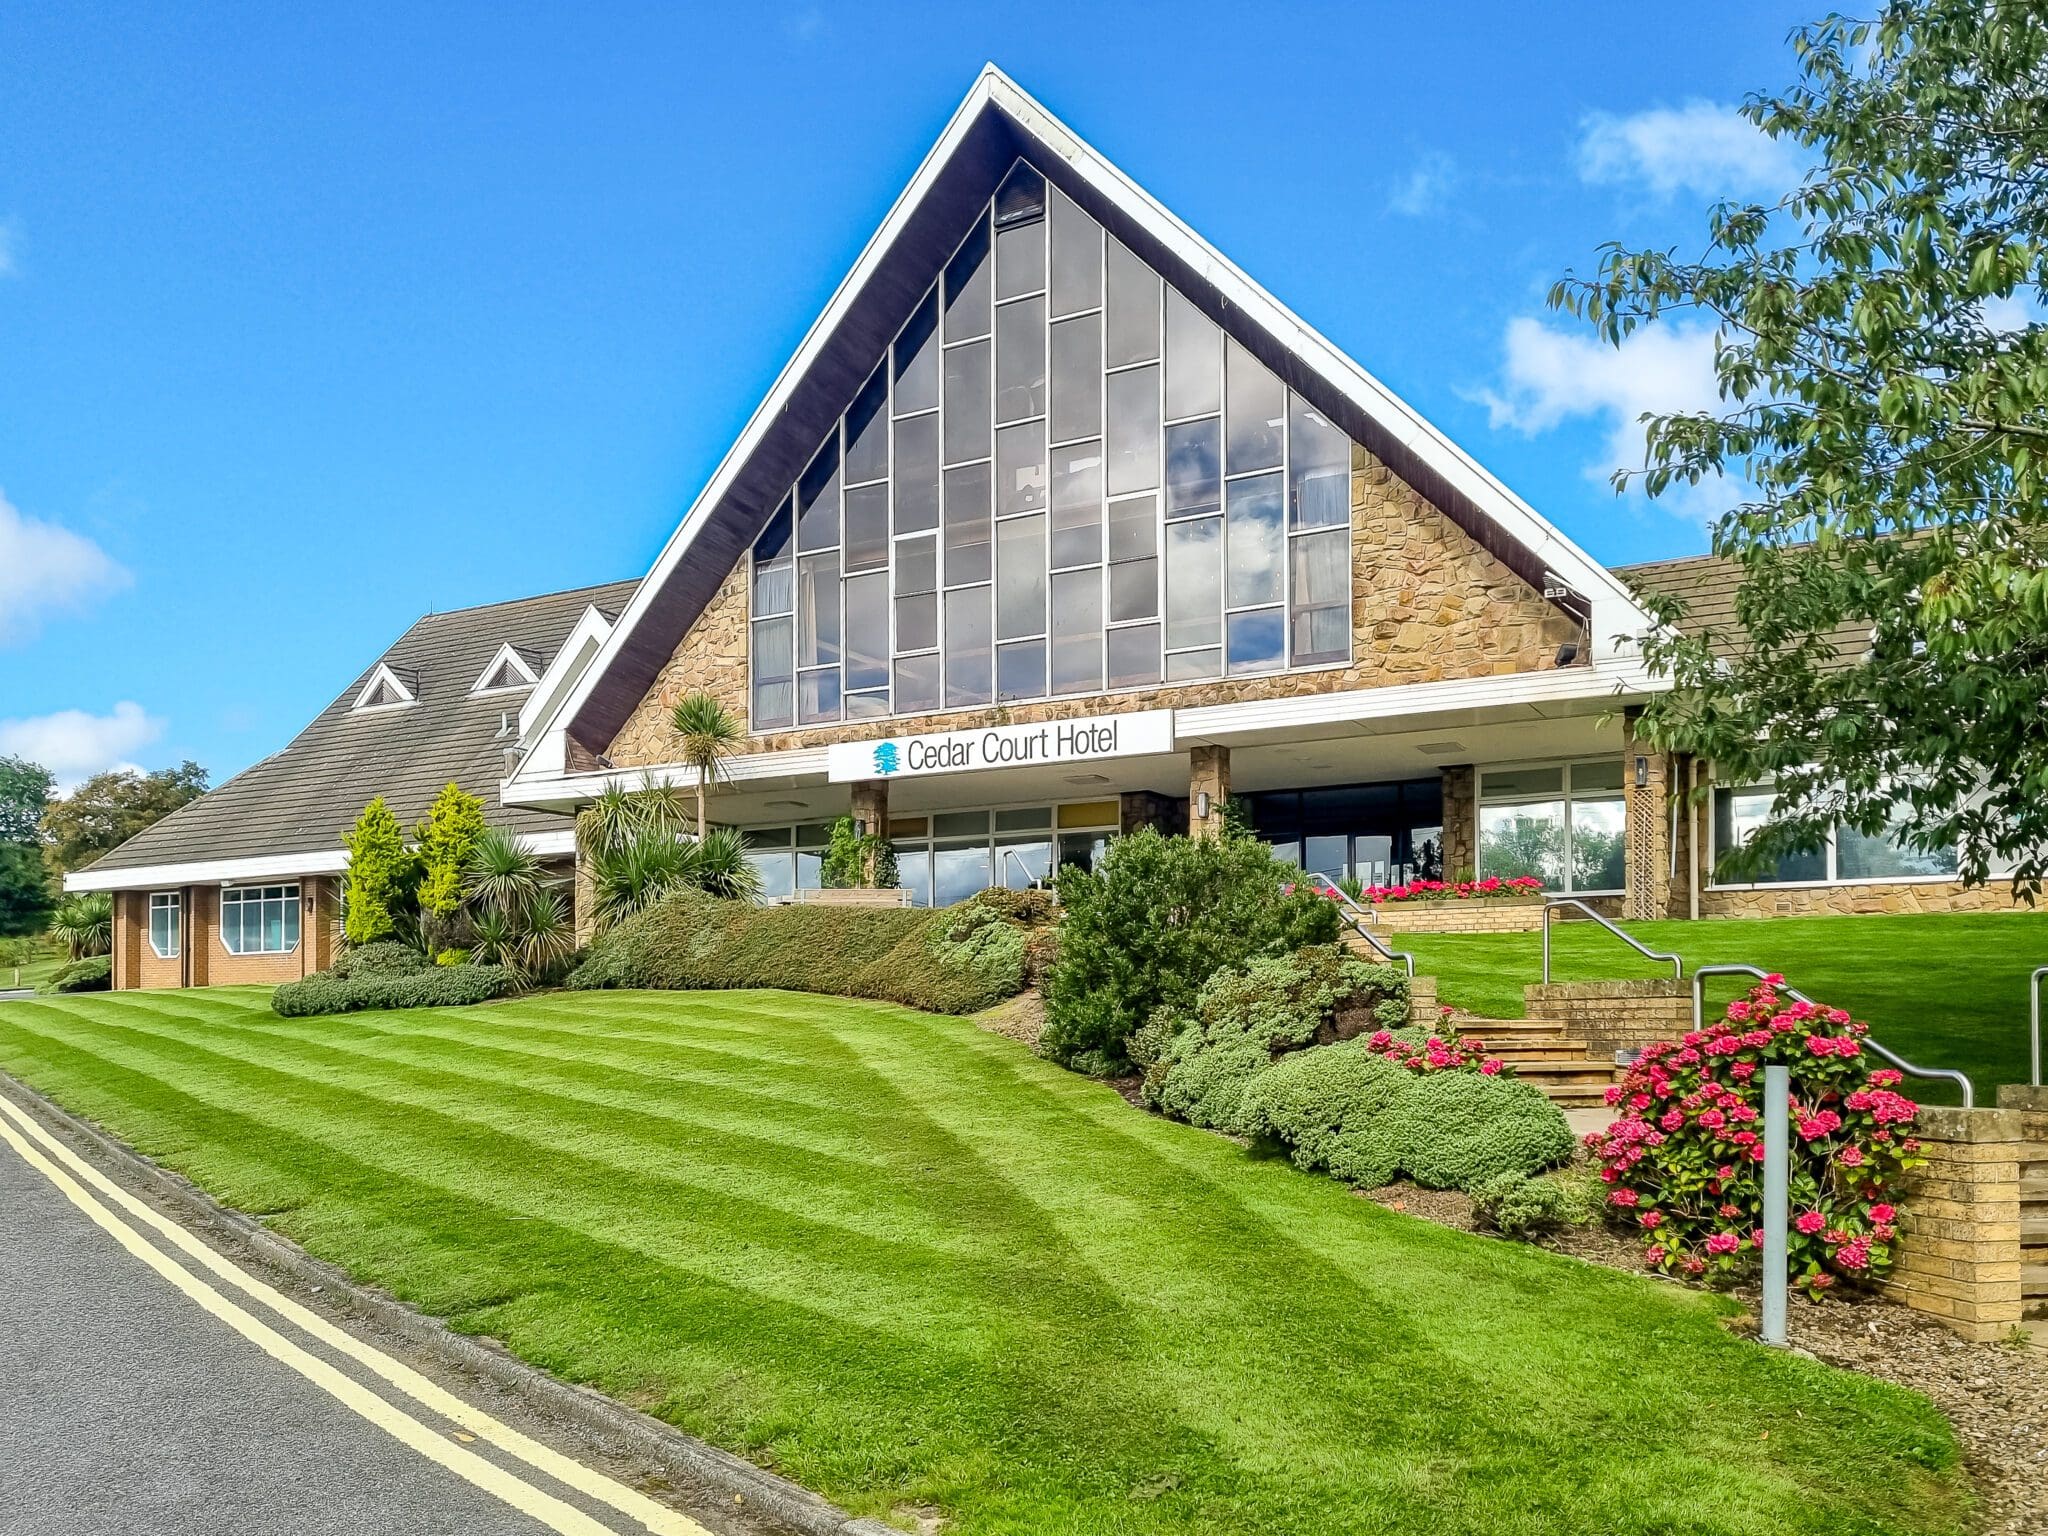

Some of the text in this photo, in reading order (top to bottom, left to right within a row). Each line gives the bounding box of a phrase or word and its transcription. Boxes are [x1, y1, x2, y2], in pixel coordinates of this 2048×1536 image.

[908, 719, 1117, 770] Cedar Court Hotel
